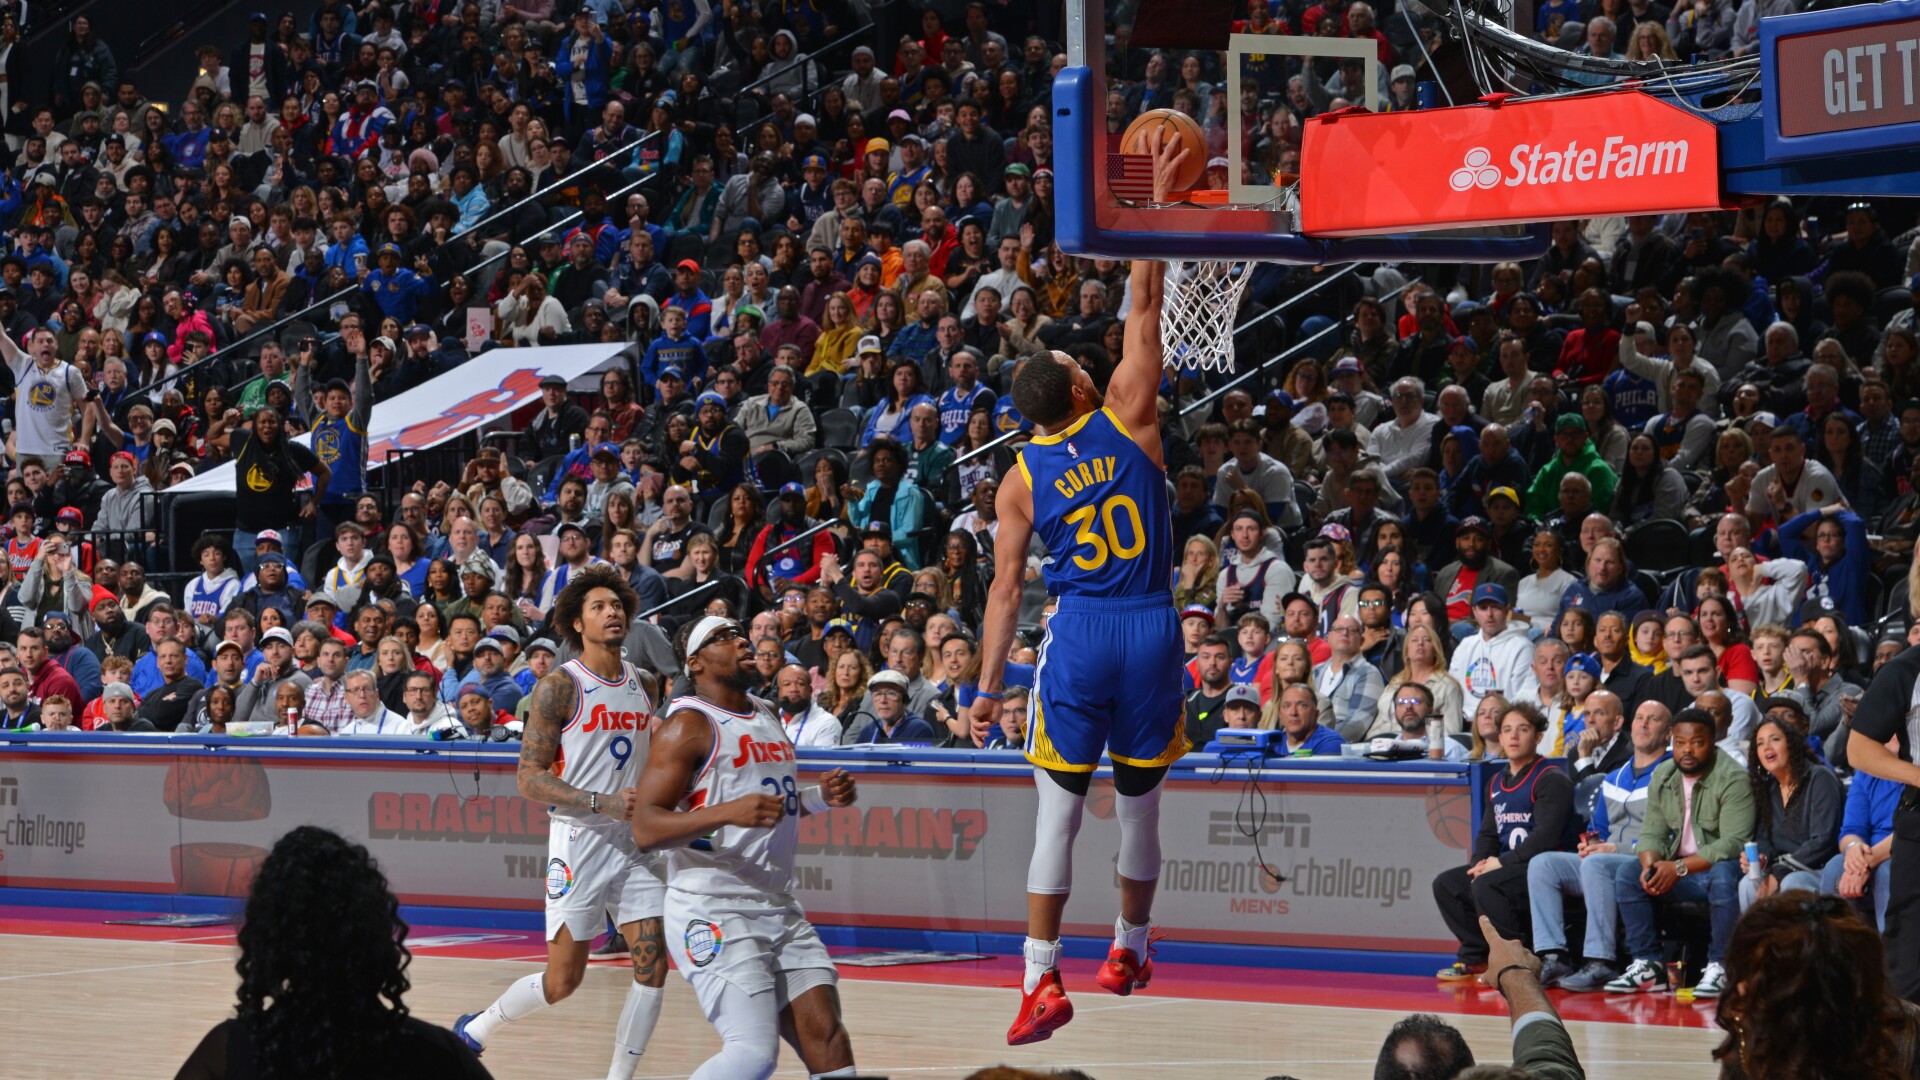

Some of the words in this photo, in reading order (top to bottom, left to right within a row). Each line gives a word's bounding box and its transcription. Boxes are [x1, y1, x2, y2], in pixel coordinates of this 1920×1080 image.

[1823, 43, 1887, 115] GET
[1054, 456, 1116, 499] CURRY
[1061, 494, 1146, 571] 30
[582, 703, 651, 733] Sixers
[609, 735, 633, 771] 9
[1207, 810, 1312, 849] ESPN
[1229, 898, 1289, 915] MEN'S
